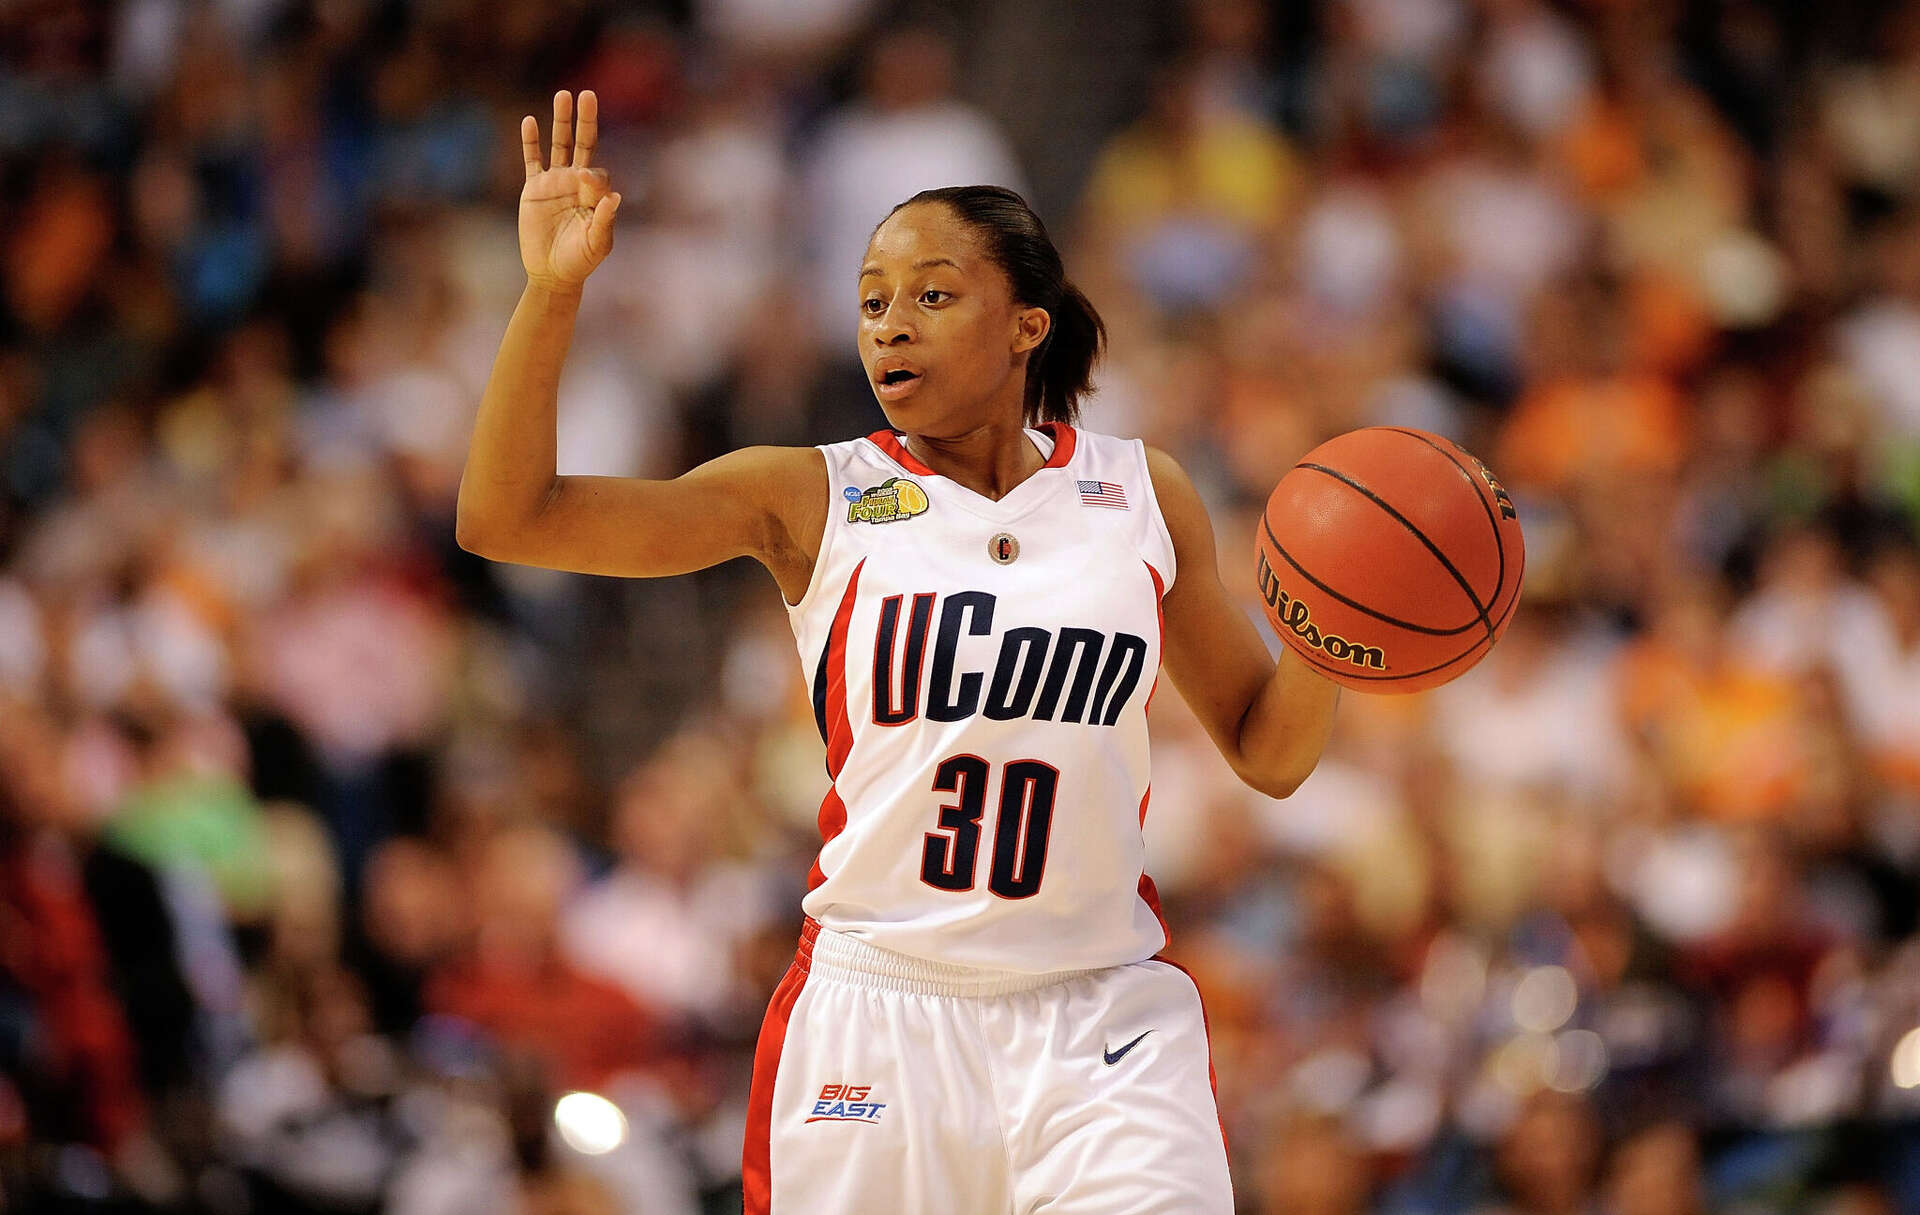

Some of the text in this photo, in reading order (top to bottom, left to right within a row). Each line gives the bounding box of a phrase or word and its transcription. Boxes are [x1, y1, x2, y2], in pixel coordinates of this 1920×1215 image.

[848, 502, 897, 521] FOUR
[1257, 546, 1386, 670] Wilson
[872, 590, 1148, 728] UConn
[919, 753, 1061, 901] 30
[811, 1100, 887, 1119] EAST
[818, 1083, 872, 1102] BIG
